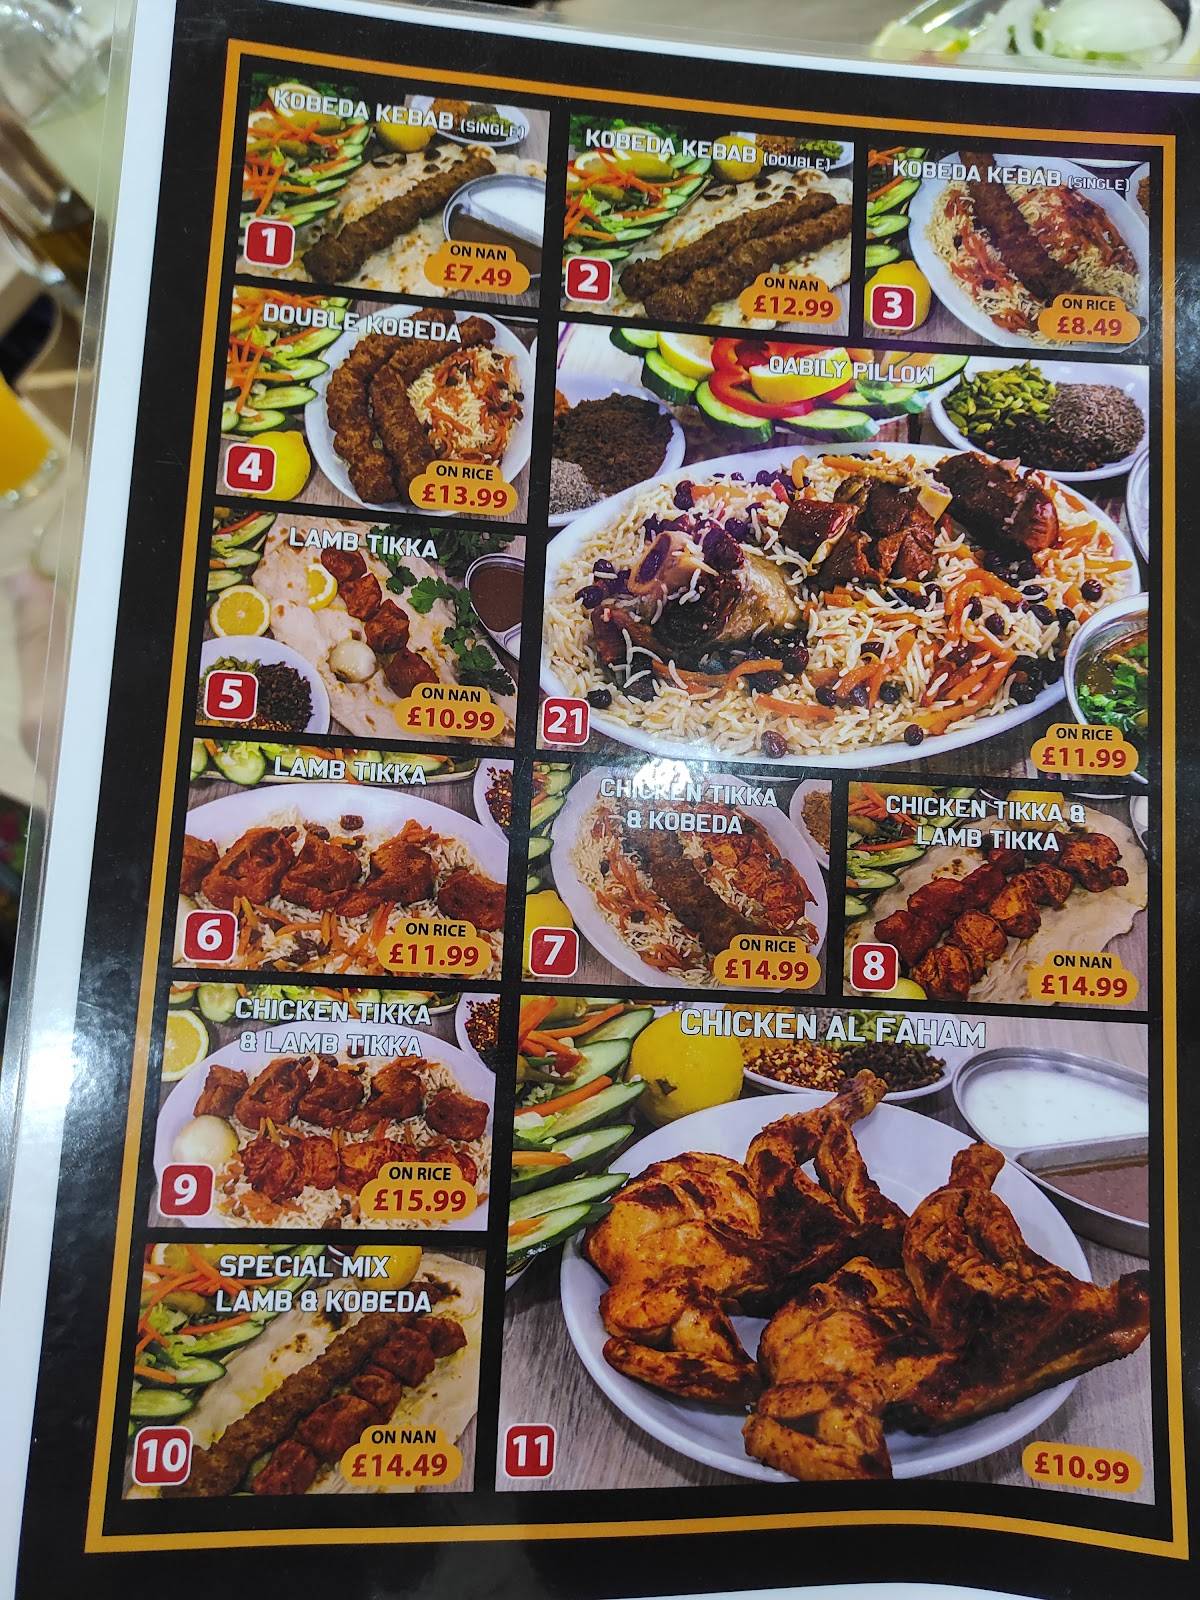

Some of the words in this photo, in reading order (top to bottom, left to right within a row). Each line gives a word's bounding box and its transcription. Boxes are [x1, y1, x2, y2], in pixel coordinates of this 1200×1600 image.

[273, 88, 368, 119] KOBEDA
[375, 103, 454, 130] KEBAB
[586, 129, 676, 156] KOBEDA
[682, 140, 756, 163] KEBAB
[893, 159, 981, 183] KOBEDA
[987, 167, 1061, 187] KEBAB
[261, 228, 276, 257] 1
[450, 245, 471, 257] ON
[476, 248, 507, 261] NAN
[443, 263, 512, 287] £7.49
[577, 264, 598, 293] 2
[764, 278, 785, 288] ON
[789, 280, 818, 292] NAN
[753, 295, 833, 318] £12.99
[882, 291, 903, 320] 3
[1062, 298, 1082, 309] ON
[1086, 299, 1116, 311] RICE
[264, 303, 359, 333] DOUBLE
[366, 316, 462, 343] KOBEDA
[1057, 316, 1122, 336] £8.49
[769, 355, 847, 378] QABILY
[853, 362, 934, 385] PILLOW
[238, 453, 262, 482] 4
[436, 465, 458, 478] ON
[462, 467, 494, 481] RICE
[422, 483, 507, 509] £13.99
[289, 526, 359, 552] LAMB
[366, 534, 438, 559] TIKKA
[218, 679, 243, 709] 5
[421, 687, 443, 700] ON
[448, 689, 481, 702] NAN
[407, 706, 495, 731] £10.99
[546, 706, 584, 735] 21
[1056, 727, 1078, 740] ON
[1081, 728, 1112, 741] RICE
[1042, 746, 1126, 768] £11.99
[273, 756, 346, 781] LAMB
[353, 761, 427, 785] TIKKA
[709, 784, 777, 807] TIKKA
[886, 795, 987, 820] CHICKEN
[994, 800, 1063, 823] TIKKA
[1069, 803, 1086, 823] &
[627, 810, 642, 828] &
[650, 811, 742, 834] KOBEDA
[916, 829, 982, 848] LAMB
[990, 830, 1059, 852] TIKKA
[197, 919, 223, 951] 6
[406, 922, 429, 936] ON
[433, 924, 466, 938] RICE
[389, 943, 479, 967] £11.99
[543, 935, 566, 966] 7
[739, 939, 761, 952] ON
[765, 940, 796, 953] RICE
[725, 959, 809, 982] £14.99
[862, 951, 884, 981] 8
[1053, 954, 1075, 968] ON
[1080, 956, 1112, 969] NAN
[1041, 975, 1127, 998] £14.99
[235, 998, 349, 1023] CHICKEN
[355, 1002, 432, 1026] TIKKA
[681, 1008, 818, 1040] CHICKEN
[825, 1014, 866, 1043] AL
[876, 1017, 986, 1048] FAHAM
[239, 1031, 258, 1052] &
[265, 1031, 340, 1054] LAMB
[346, 1034, 423, 1057] TIKKA
[389, 1167, 412, 1181] ON
[417, 1168, 451, 1181] RICE
[173, 1173, 198, 1205] 9
[374, 1189, 467, 1212] £15.99
[219, 1255, 333, 1278] SPECIAL
[342, 1256, 389, 1278] MIX
[216, 1290, 293, 1313] LAMB
[300, 1292, 318, 1312] &
[326, 1290, 432, 1313] KOBEDA
[371, 1430, 395, 1444] ON
[401, 1430, 436, 1444] NAN
[141, 1439, 187, 1473] 10
[512, 1436, 548, 1468] 11
[352, 1453, 447, 1478] £14.49
[1034, 1451, 1130, 1484] £10.99
